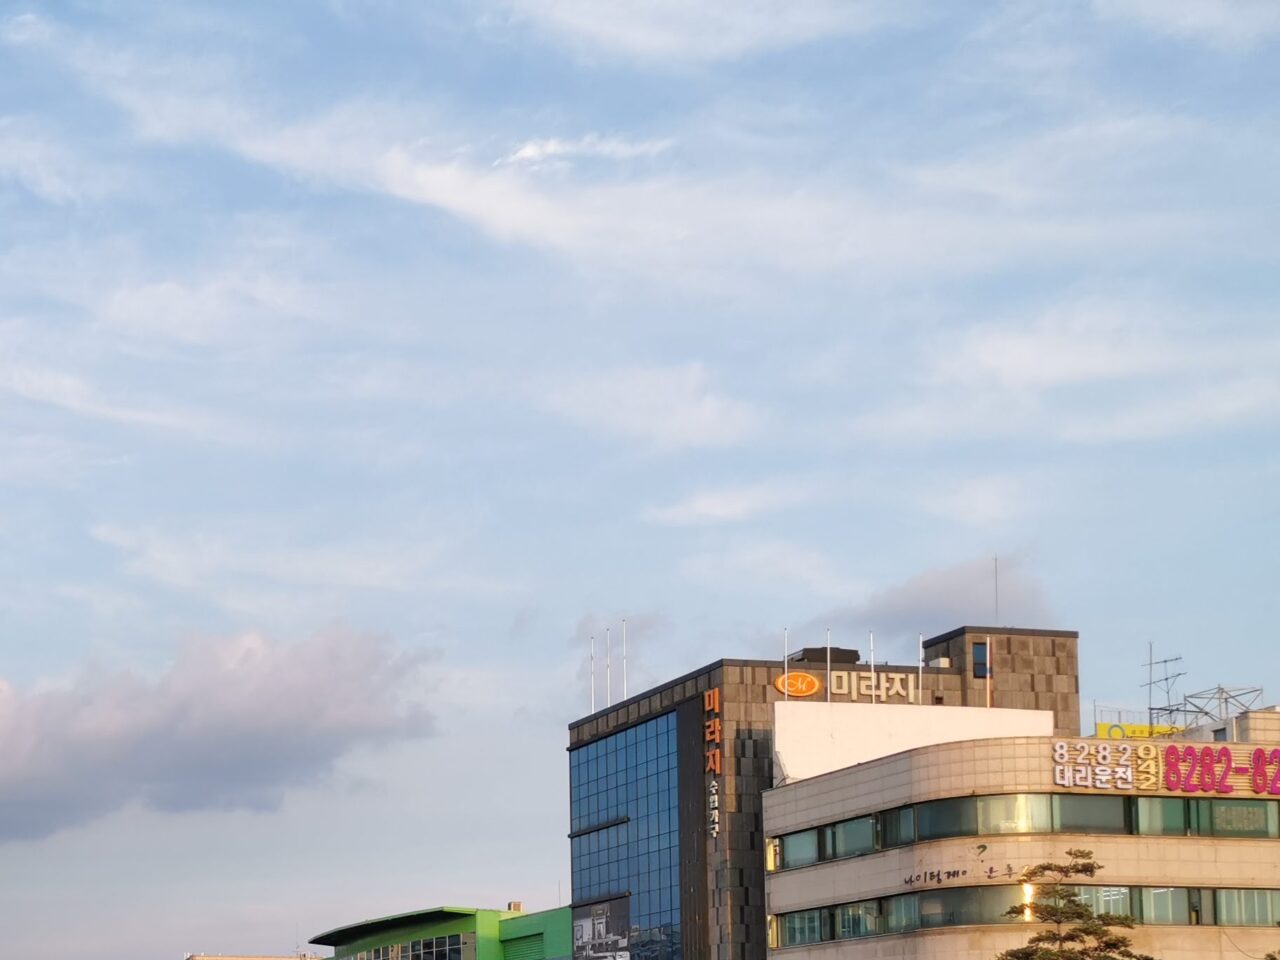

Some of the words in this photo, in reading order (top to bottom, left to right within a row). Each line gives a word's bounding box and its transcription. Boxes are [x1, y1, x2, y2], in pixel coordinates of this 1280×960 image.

[830, 670, 916, 704] 미라지
[703, 687, 721, 775] 미라지
[1054, 741, 1134, 765] 8282
[1054, 766, 1134, 790] 대리운전
